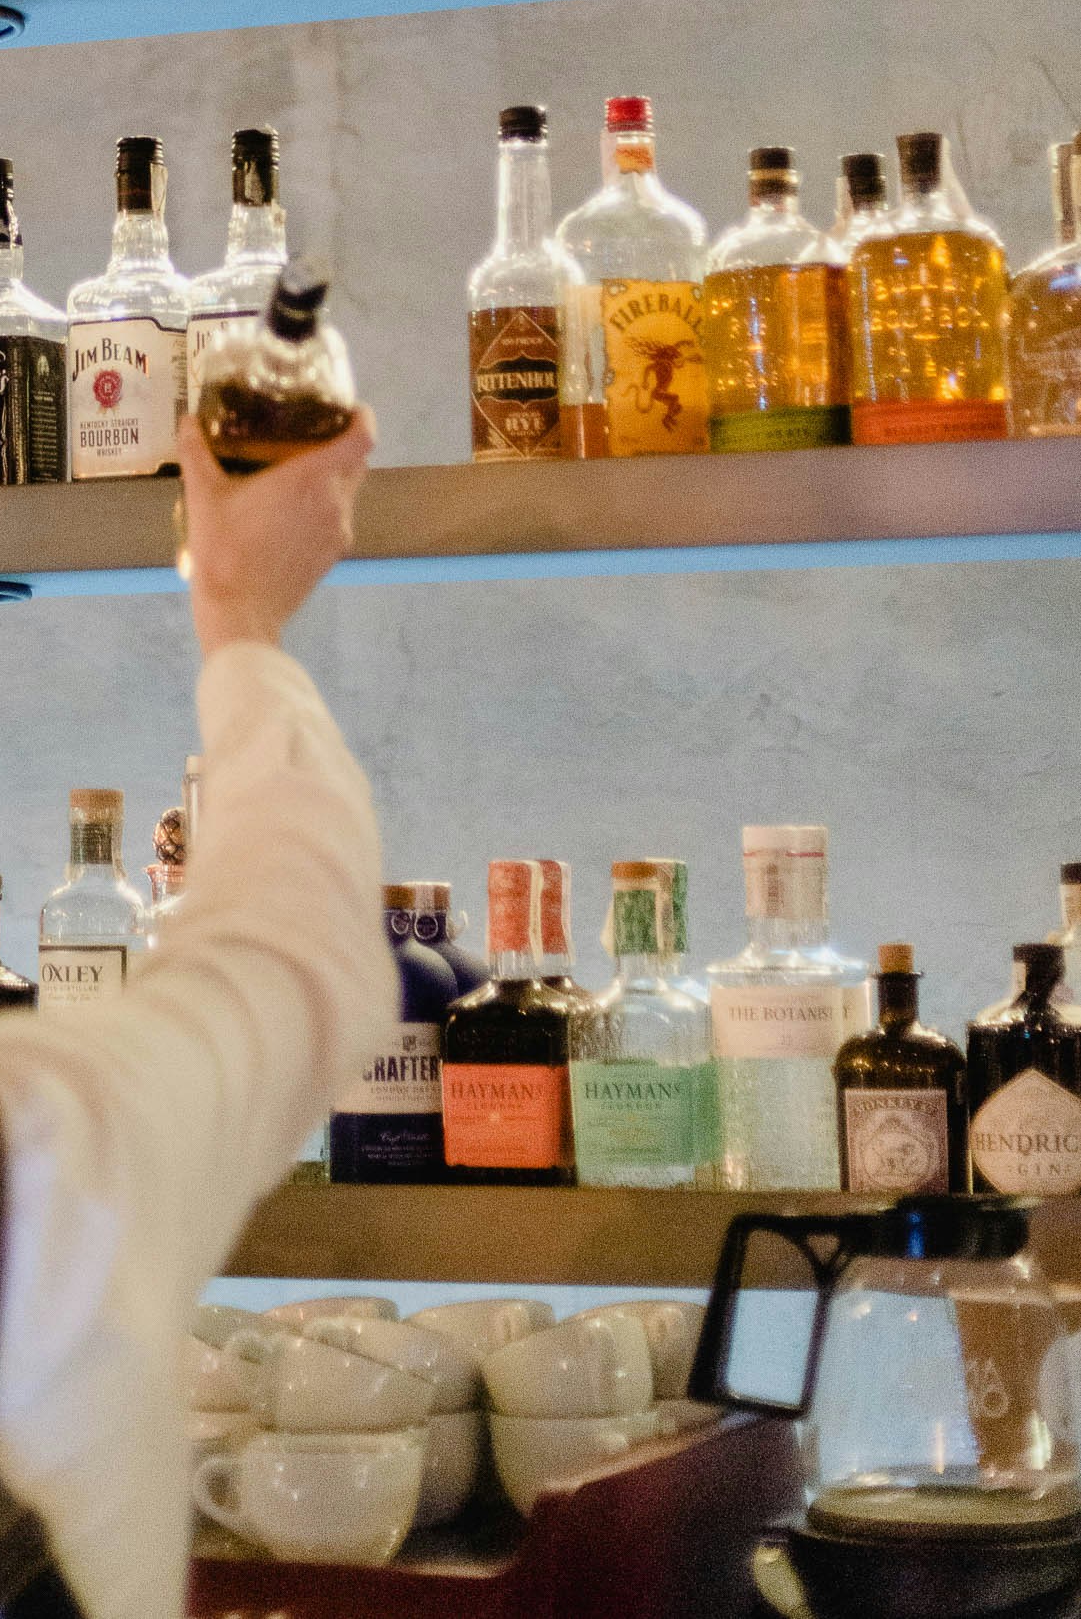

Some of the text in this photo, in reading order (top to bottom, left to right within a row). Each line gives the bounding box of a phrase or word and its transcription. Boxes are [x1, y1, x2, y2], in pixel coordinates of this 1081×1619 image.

[608, 293, 704, 334] FIREBALL
[72, 337, 150, 382] JIM BEAM
[80, 417, 139, 430] KENTUCKY STRAIGHT
[80, 427, 139, 448] BOURBON
[97, 447, 123, 457] WHISKEY
[41, 963, 104, 983] OXLEY
[728, 1005, 758, 1022] THE
[363, 1055, 440, 1082] RAFTER
[974, 1132, 1081, 1157] HENDRIC
[1017, 1162, 1062, 1175] GIN
